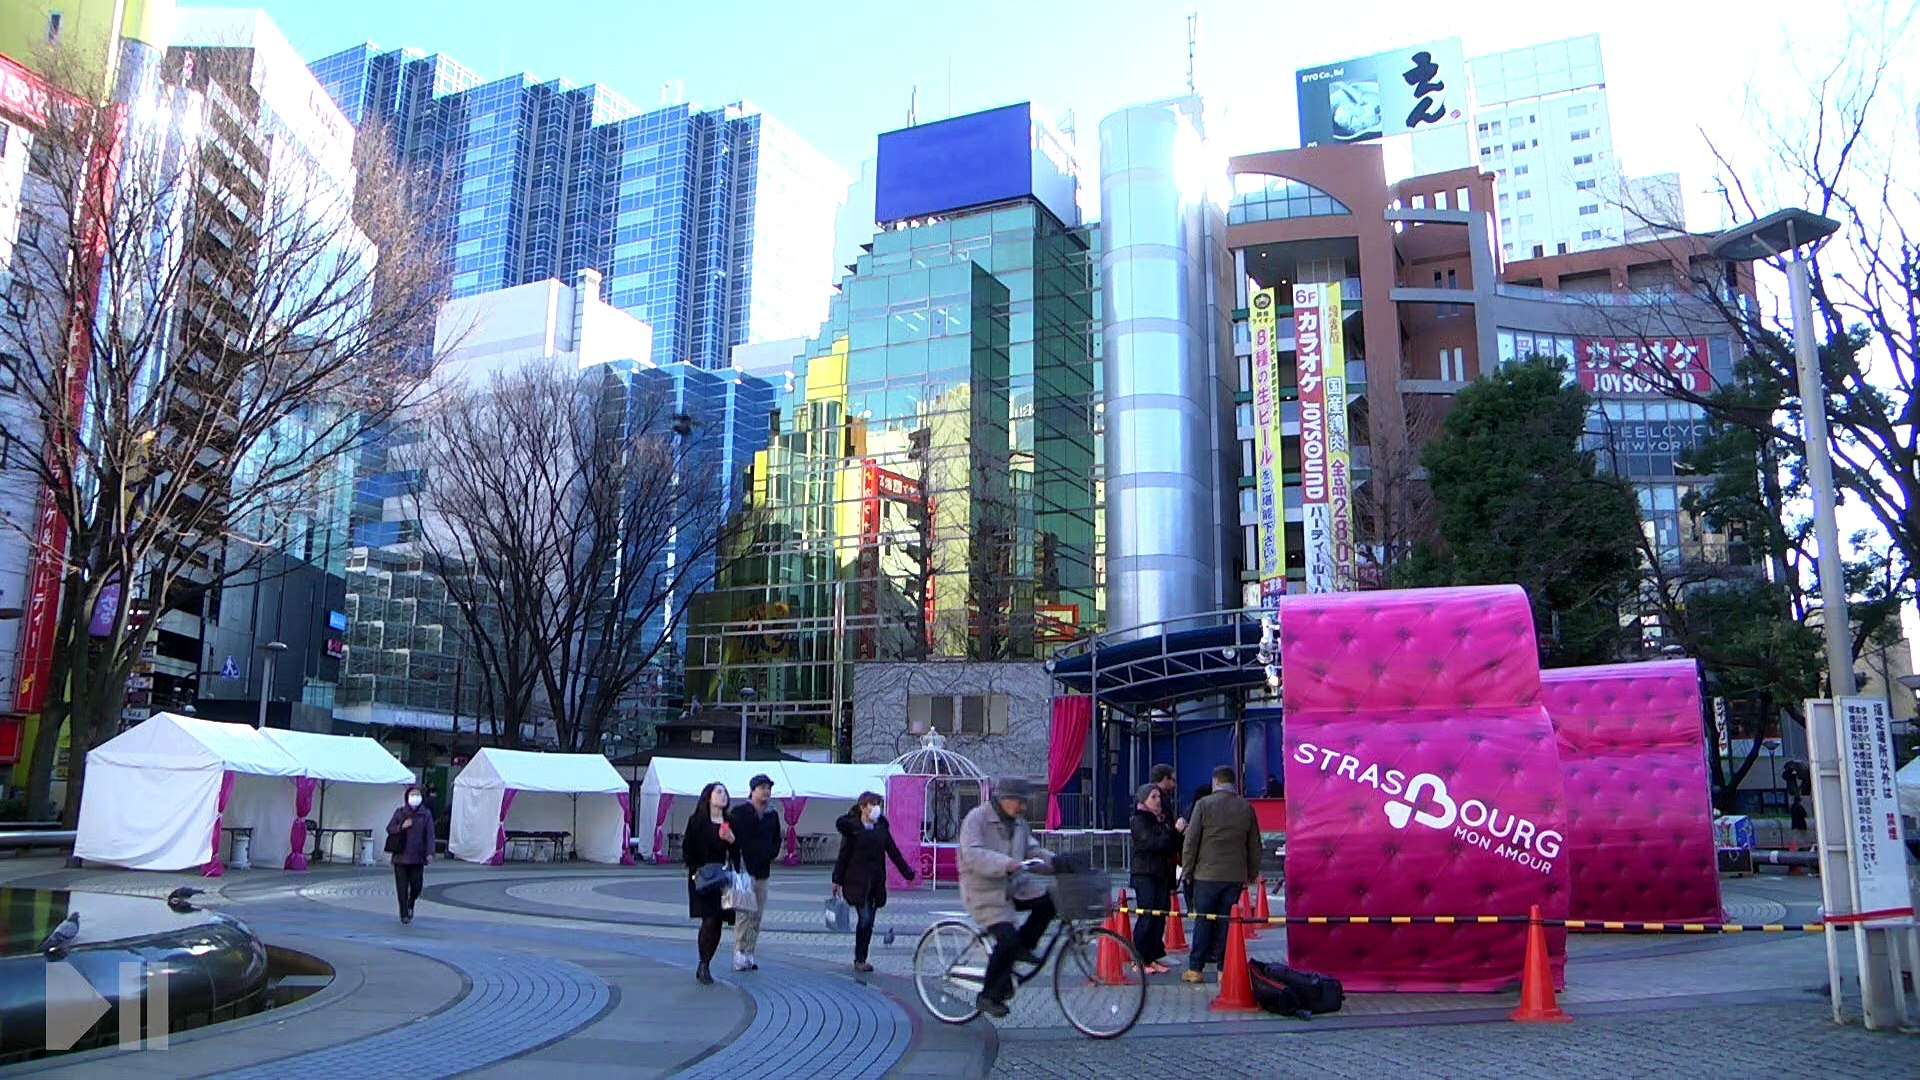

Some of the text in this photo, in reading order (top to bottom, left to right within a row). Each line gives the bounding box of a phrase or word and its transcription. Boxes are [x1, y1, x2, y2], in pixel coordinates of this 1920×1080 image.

[1402, 51, 1446, 128] えん
[1295, 289, 1317, 304] 6F
[1585, 340, 1699, 369] カラオケ
[1298, 311, 1325, 500] カラオケ JOYSOUND
[1593, 372, 1696, 393] JOYSOUD
[1293, 742, 1563, 859] STRASBOURG
[1453, 825, 1553, 874] MON AMOUR
